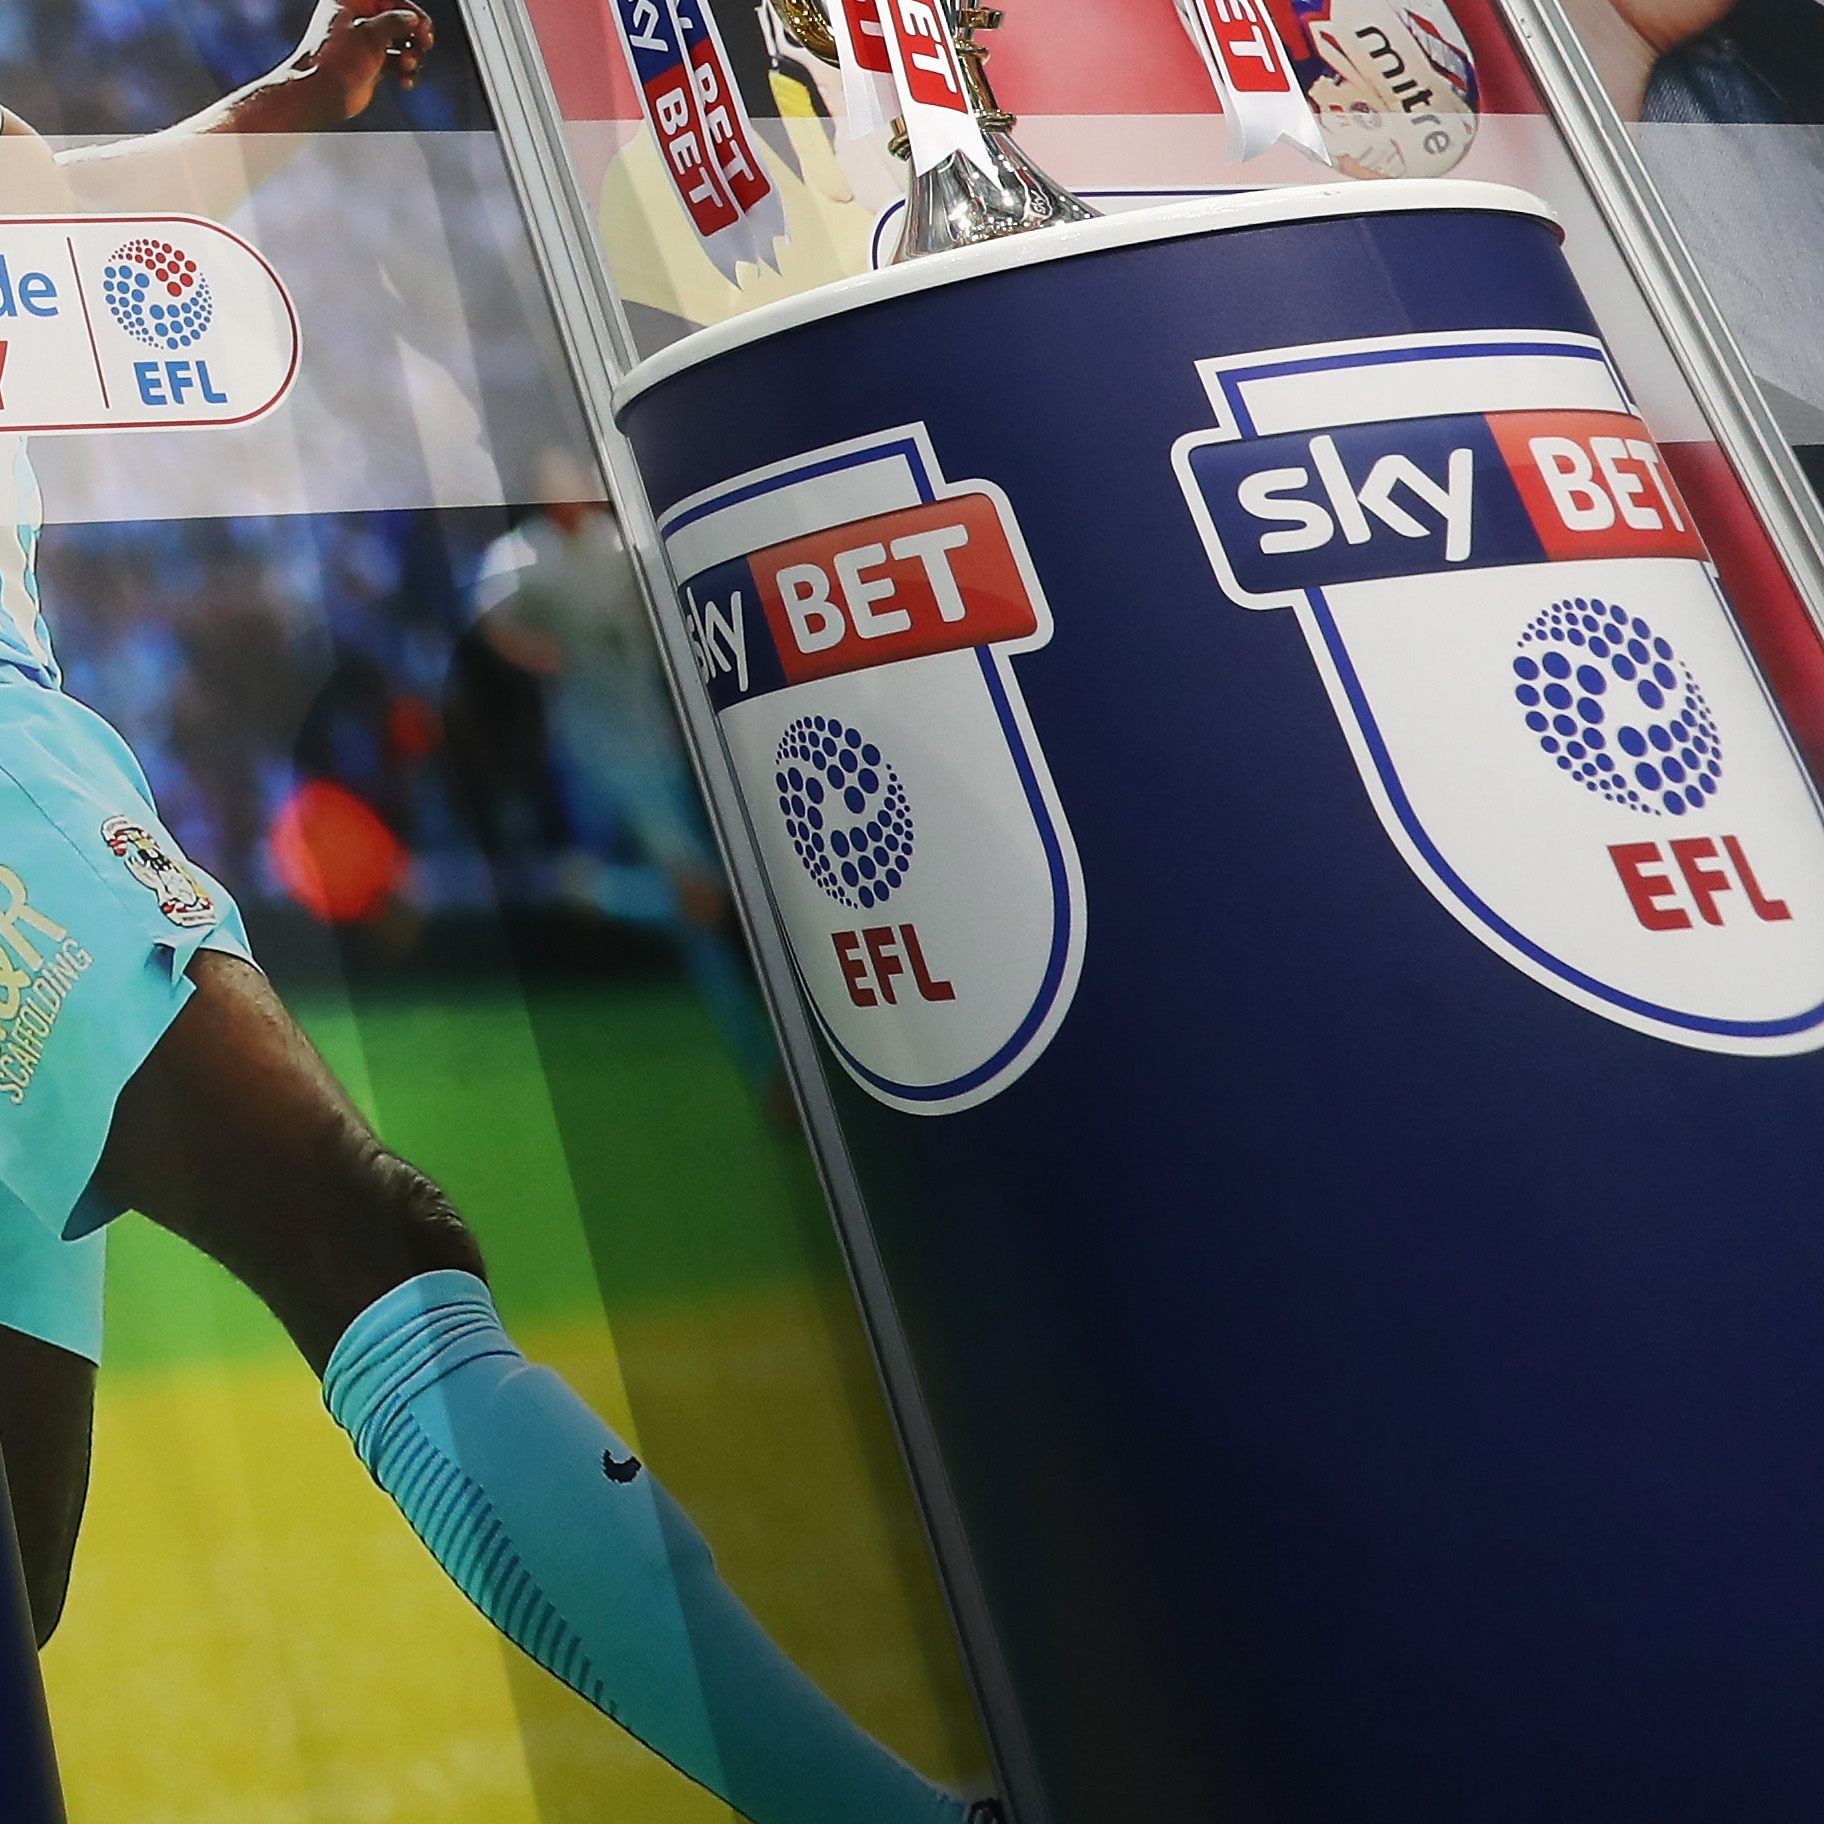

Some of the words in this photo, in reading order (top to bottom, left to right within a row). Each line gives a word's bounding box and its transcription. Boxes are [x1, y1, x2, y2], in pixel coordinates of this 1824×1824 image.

[657, 87, 723, 210] BET
[1355, 26, 1450, 155] mitre
[133, 360, 228, 406] EFL
[1238, 434, 1474, 564] sky
[1528, 436, 1686, 532] BET
[775, 525, 971, 657] BET
[1608, 836, 1795, 933] EFL
[831, 924, 956, 1011] EFL
